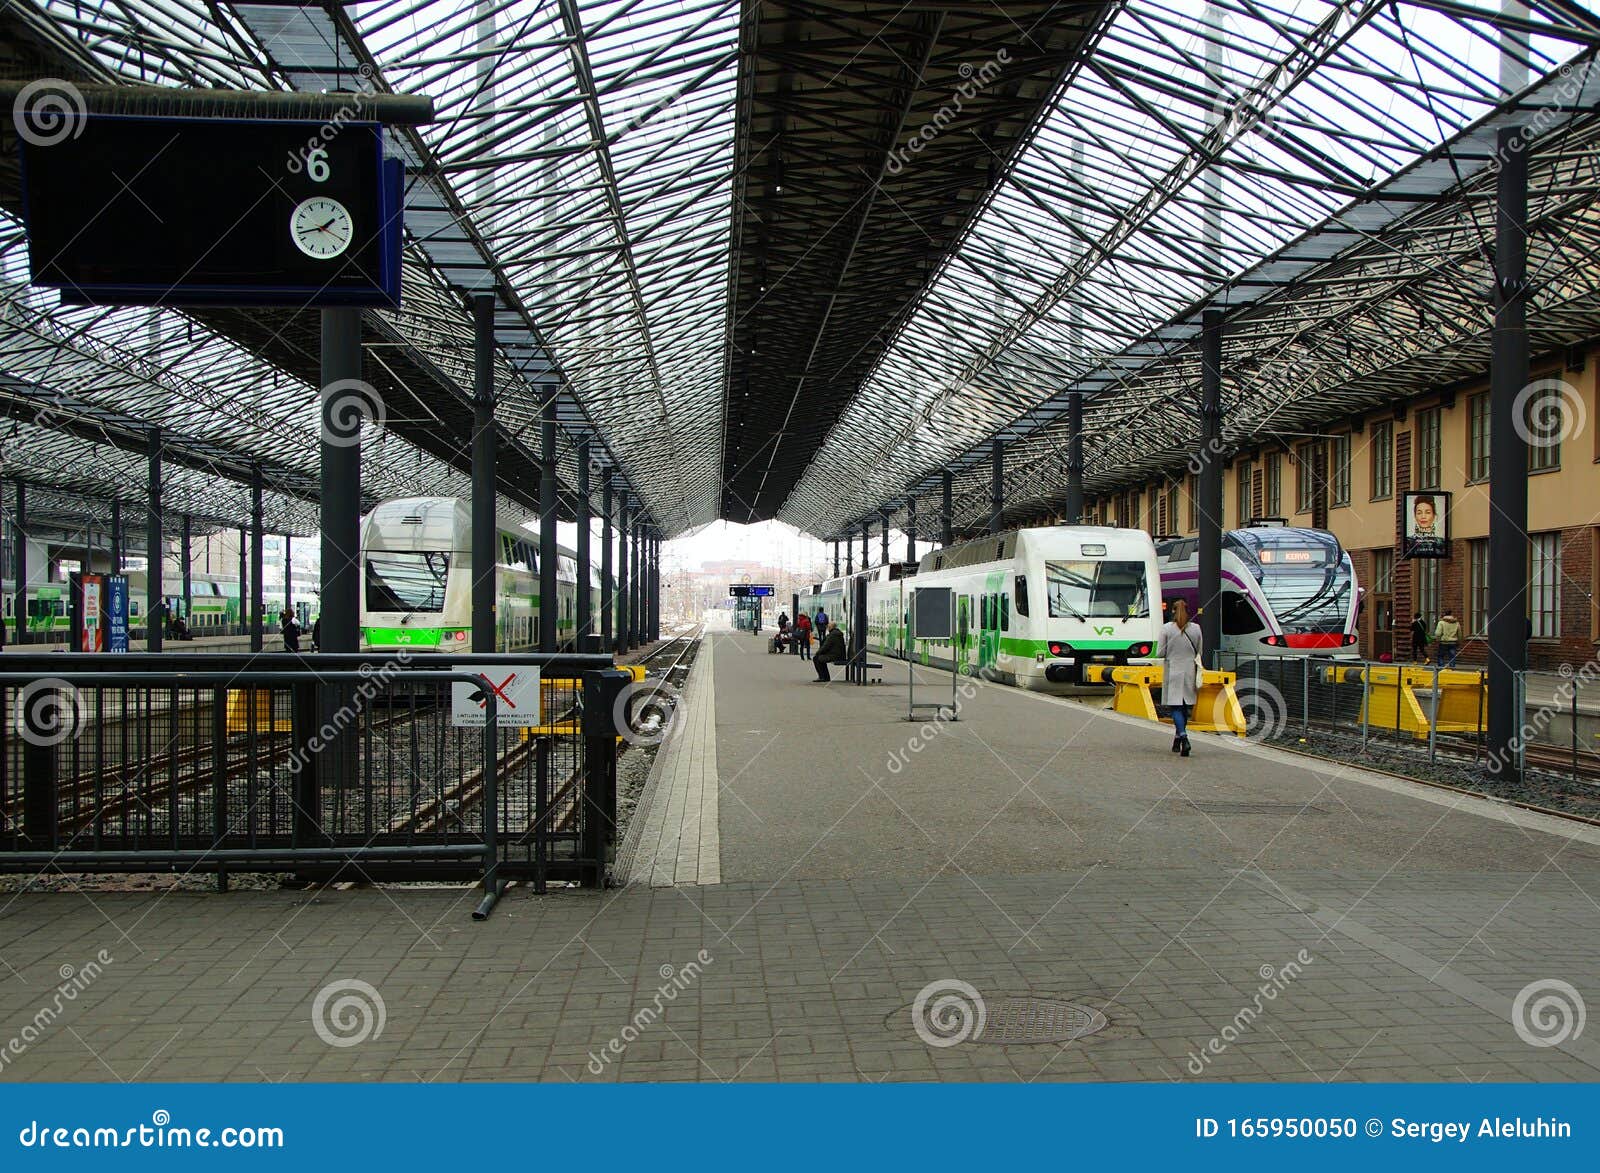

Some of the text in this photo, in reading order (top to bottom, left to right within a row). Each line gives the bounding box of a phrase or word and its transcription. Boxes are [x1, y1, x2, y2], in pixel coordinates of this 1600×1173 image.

[307, 148, 331, 182] 6
[1093, 625, 1114, 636] VR
[396, 635, 412, 643] VR
